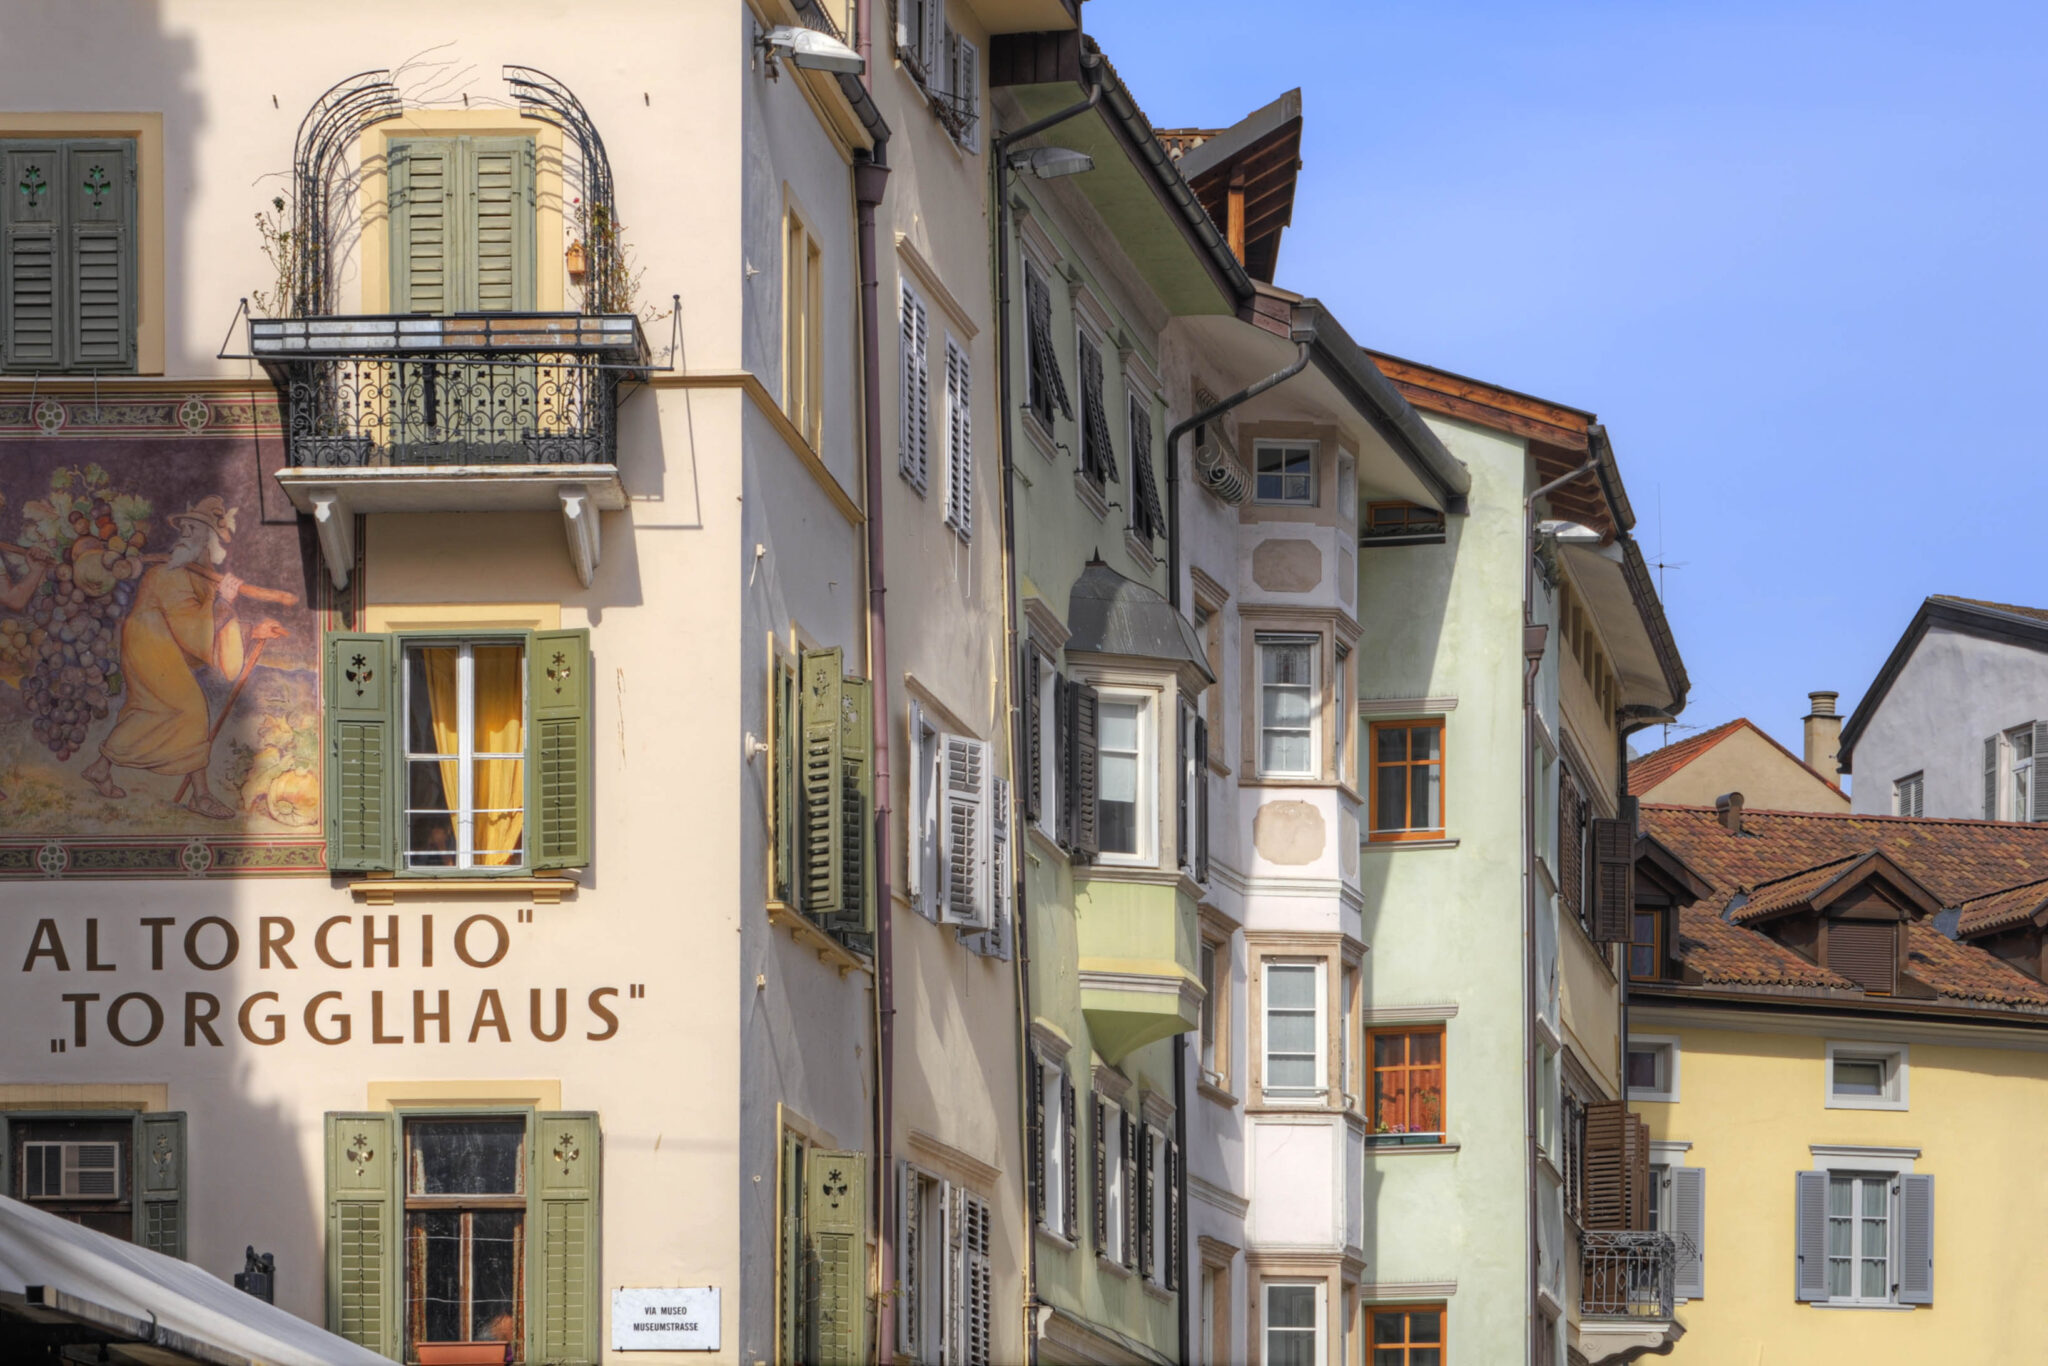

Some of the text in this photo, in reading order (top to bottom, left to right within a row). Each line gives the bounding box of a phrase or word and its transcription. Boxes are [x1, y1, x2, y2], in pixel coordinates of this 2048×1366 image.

[22, 918, 117, 972] AL
[644, 1306, 688, 1315] VIA MUSEO
[633, 1322, 699, 1331] MUSEUMSTRASSE
